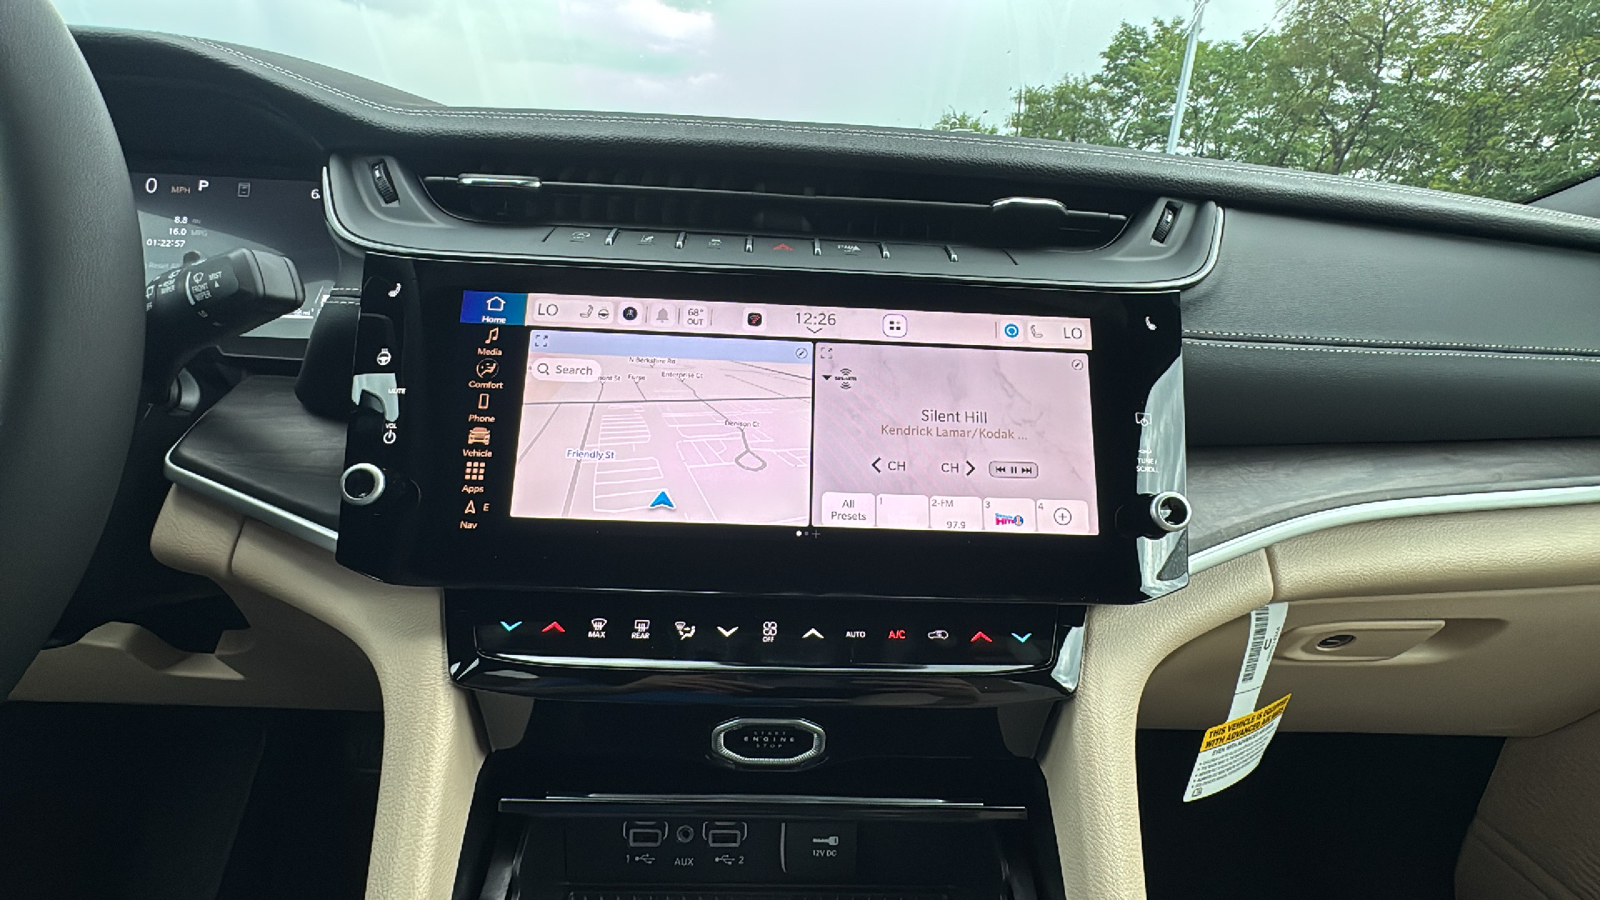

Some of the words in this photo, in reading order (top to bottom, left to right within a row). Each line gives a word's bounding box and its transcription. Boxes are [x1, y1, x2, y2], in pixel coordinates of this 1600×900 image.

[145, 177, 158, 194] 0
[171, 186, 191, 194] MPH
[198, 180, 209, 191] P
[174, 216, 188, 224] 8.8
[169, 228, 187, 236] 16.0
[146, 239, 186, 248] 01:22:57
[537, 303, 559, 317] LO
[481, 315, 507, 324] Home
[687, 318, 704, 326] OUT
[796, 312, 837, 326] 12:26
[1063, 327, 1083, 340] LO
[477, 348, 503, 356] Media
[555, 365, 593, 376] Search
[468, 380, 504, 389] Comfort
[468, 414, 495, 423] Phone
[921, 409, 961, 423] Silent
[965, 411, 988, 424] Hill
[881, 424, 933, 437] Kendrick
[936, 427, 1015, 439] Lamar/Kodak
[463, 449, 493, 458] Vehicle
[567, 450, 603, 461] Friendly
[605, 451, 614, 459] St
[887, 461, 906, 471] CH
[941, 463, 959, 473] CH
[461, 485, 484, 494] Apps
[483, 503, 490, 511] E
[842, 499, 855, 508] All
[931, 499, 954, 507] 2-FM
[831, 511, 867, 521] Presets
[460, 521, 478, 529] Nav
[946, 521, 966, 529] 97.9
[845, 630, 866, 638] AUTO
[888, 629, 906, 639] A/C
[1209, 726, 1227, 739] THIS
[1227, 714, 1256, 732] VEHICLE
[1205, 736, 1224, 748] WITH
[1226, 722, 1261, 741] ADVANCED
[626, 855, 630, 863] 1
[674, 857, 694, 866] AUX
[738, 856, 744, 864] 2
